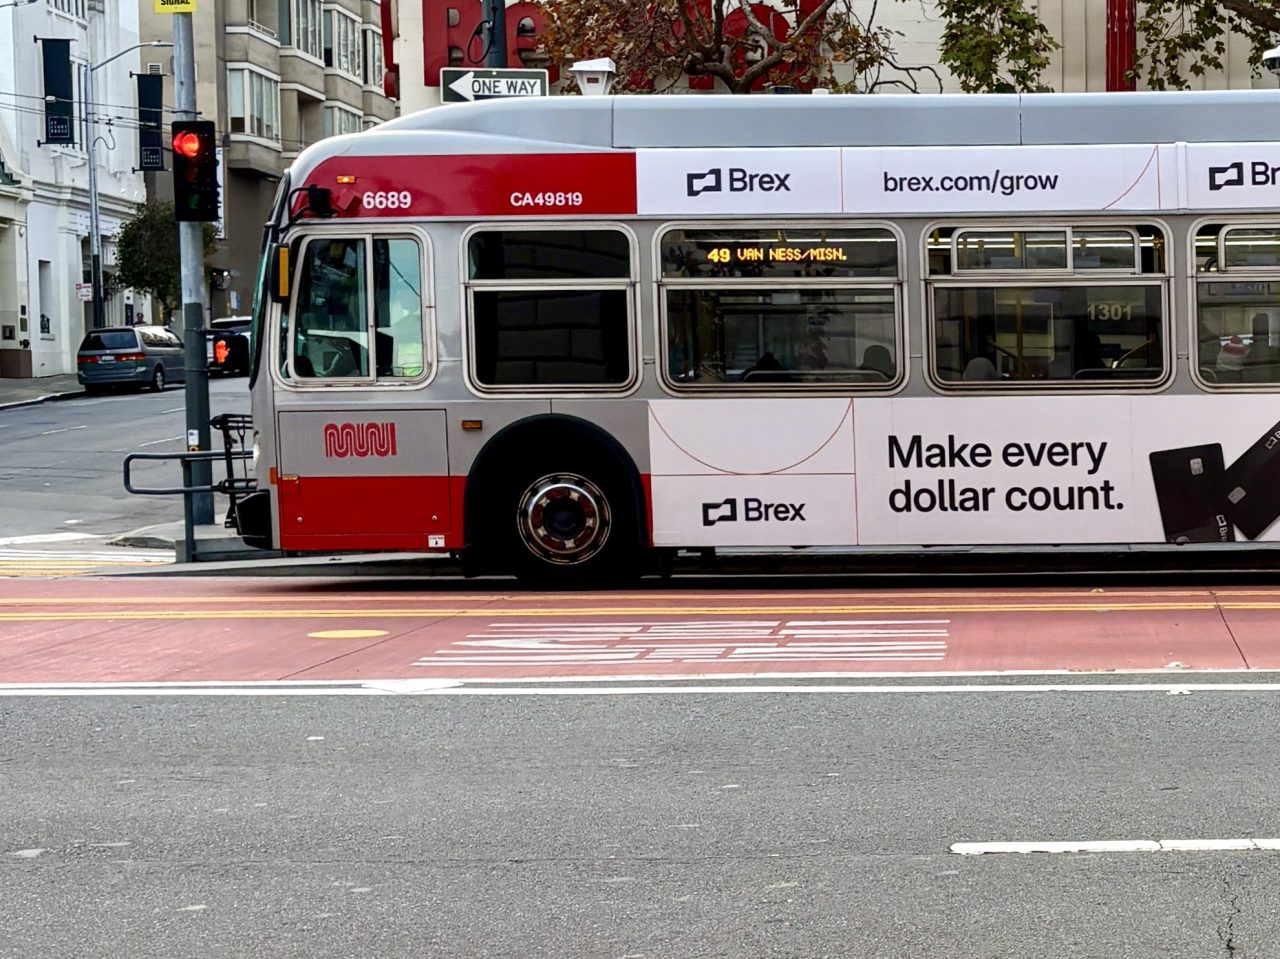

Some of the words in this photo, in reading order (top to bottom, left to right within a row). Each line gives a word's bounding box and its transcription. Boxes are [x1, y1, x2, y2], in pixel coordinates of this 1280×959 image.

[471, 79, 503, 94] ONE
[506, 80, 538, 94] WAY
[729, 167, 791, 192] Brex
[883, 169, 1059, 196] brex.com/grow
[362, 190, 412, 209] 6689
[510, 191, 583, 207] CA49819
[706, 247, 731, 263] 49
[737, 248, 764, 261] VAN
[769, 247, 848, 261] NESS/MISN.
[1087, 303, 1132, 321] 1301
[888, 434, 993, 469] Make
[1002, 441, 1108, 475] every
[888, 478, 996, 513] dollar
[1005, 479, 1124, 512] count.
[744, 497, 806, 522] Brex
